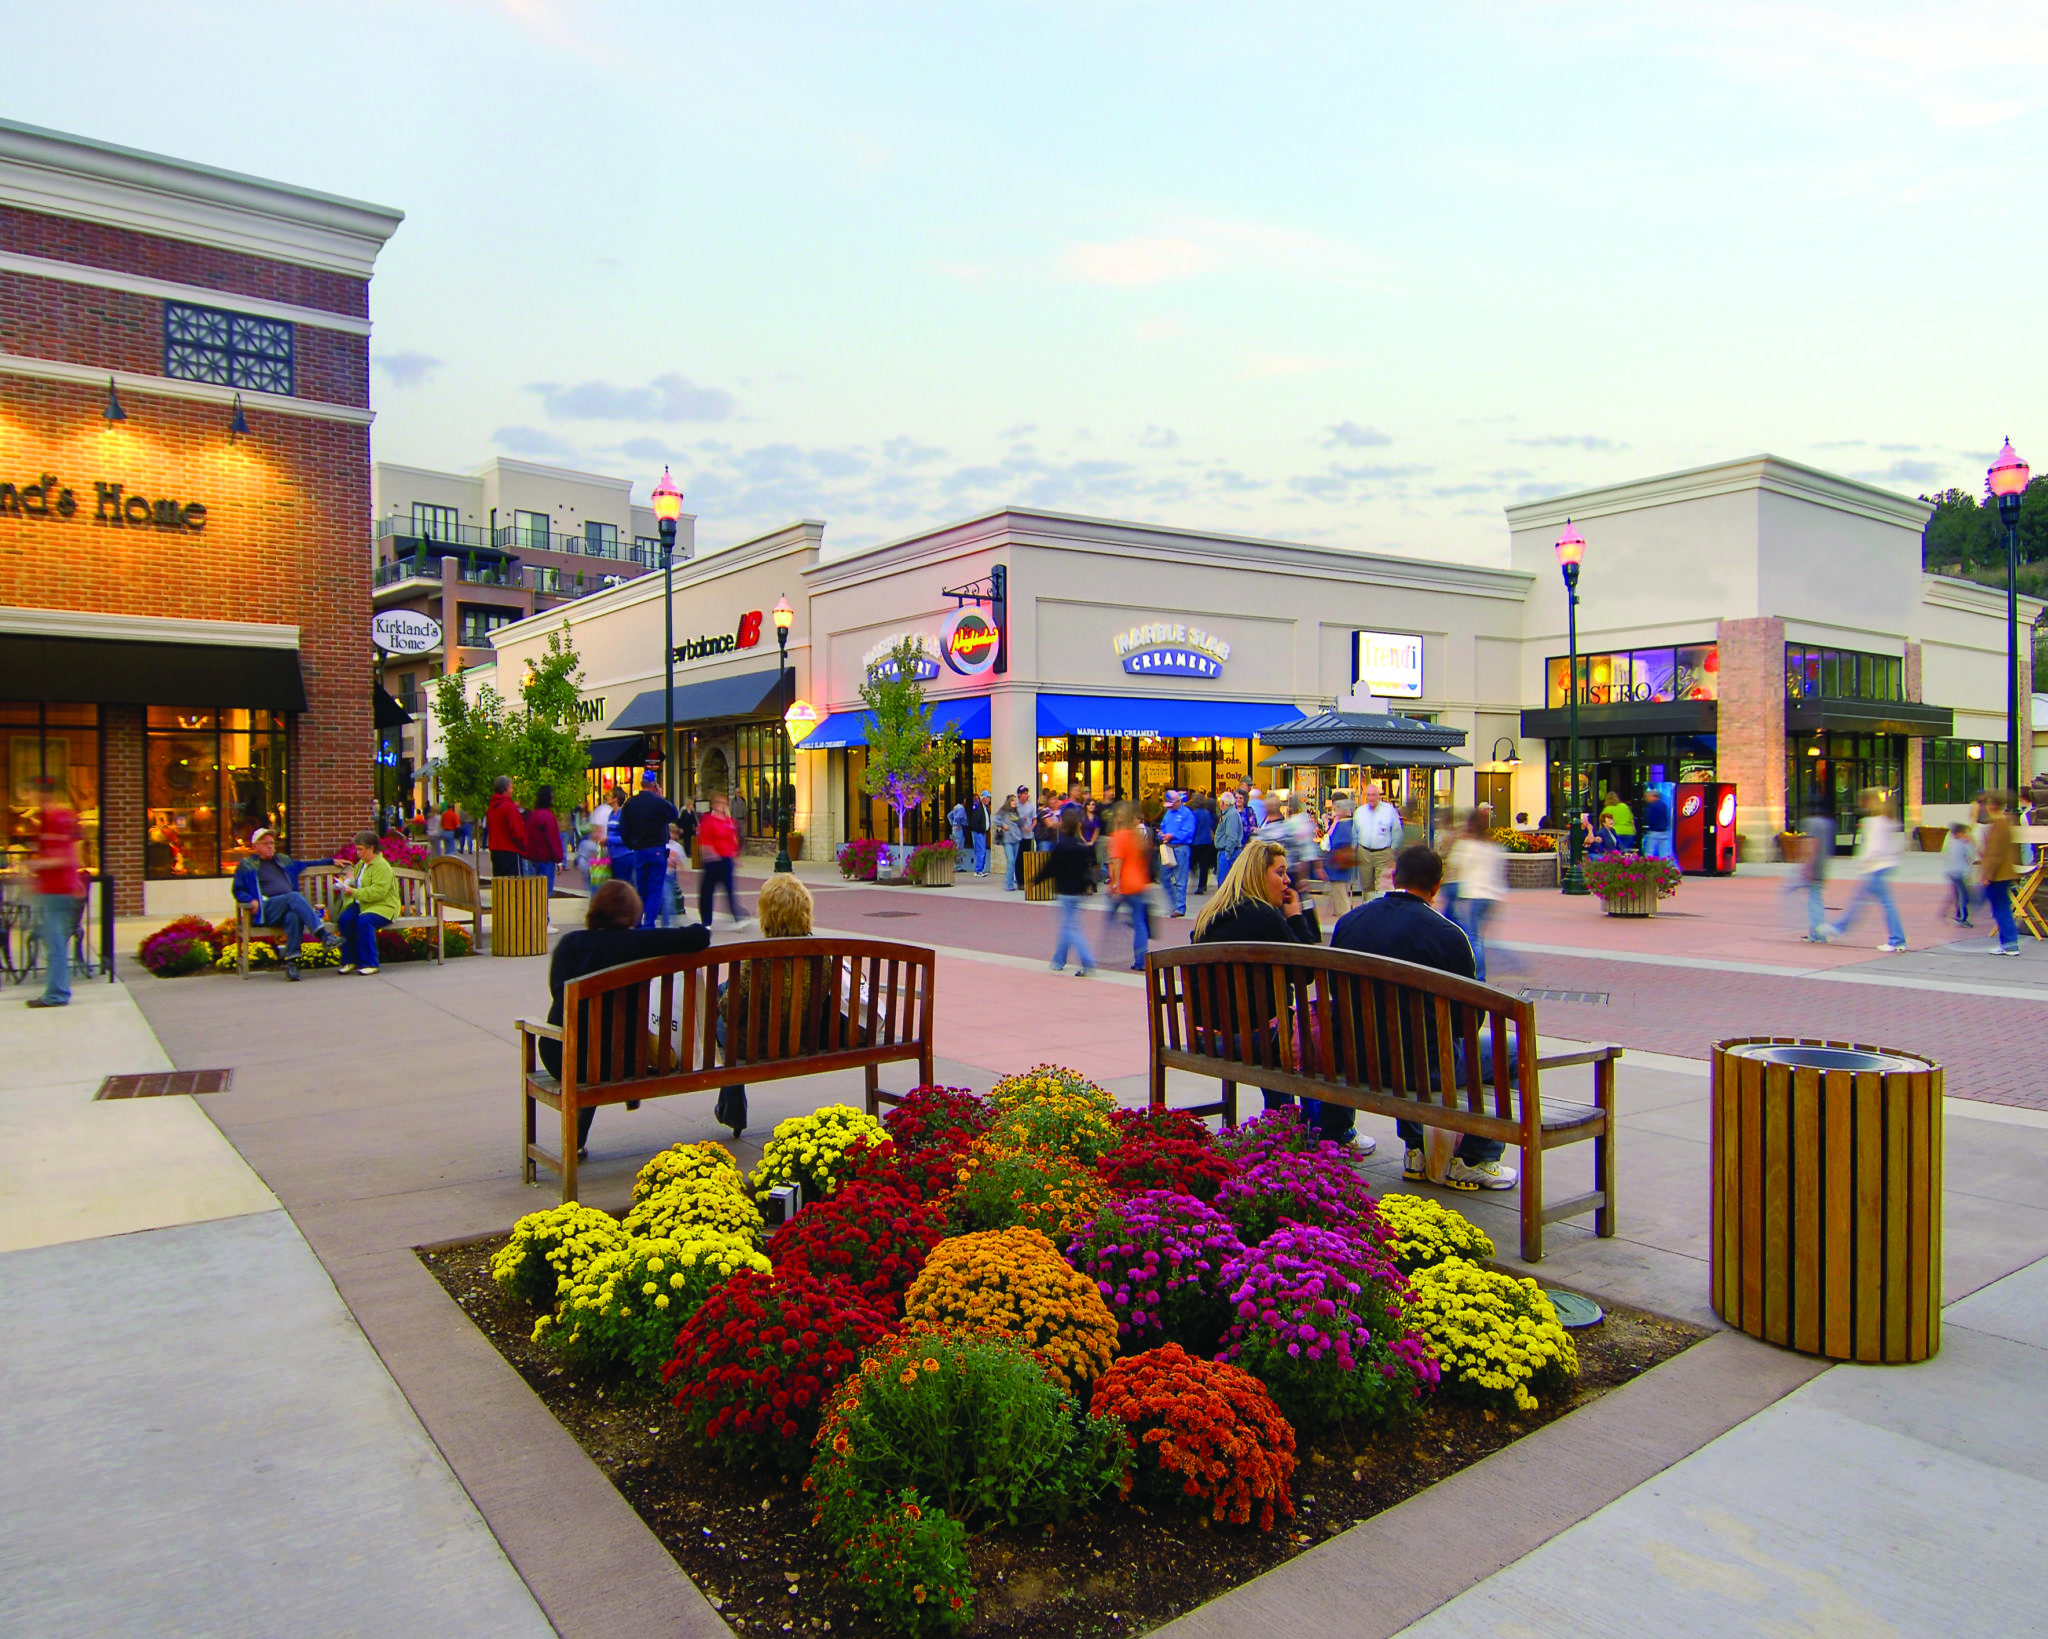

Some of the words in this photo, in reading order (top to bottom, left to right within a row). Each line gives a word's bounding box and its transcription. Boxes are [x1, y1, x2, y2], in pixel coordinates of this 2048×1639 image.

[94, 481, 207, 528] Home
[375, 618, 439, 637] Kirkland's
[390, 634, 426, 650] Home
[687, 635, 735, 660] balance
[1113, 623, 1187, 656] MARBLE
[1188, 628, 1231, 662] SLAB
[1361, 639, 1417, 669] Trendi
[1132, 651, 1217, 676] CREAMERY
